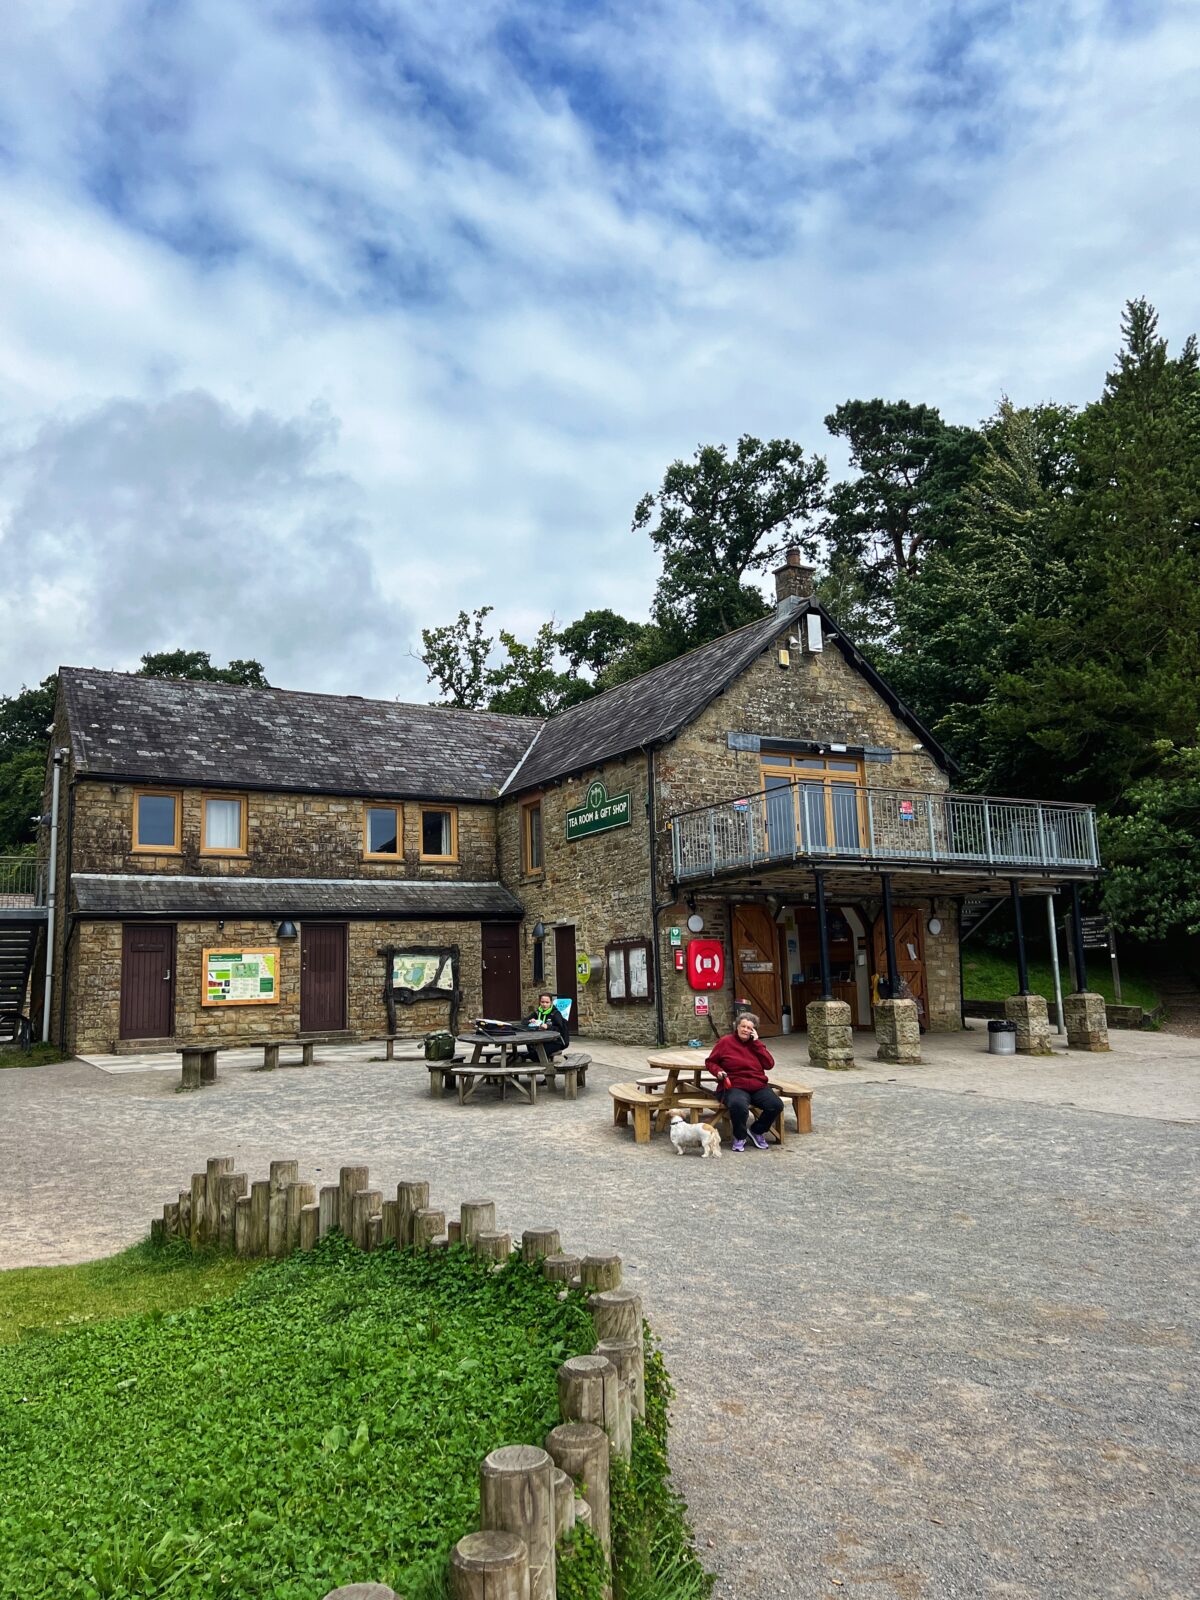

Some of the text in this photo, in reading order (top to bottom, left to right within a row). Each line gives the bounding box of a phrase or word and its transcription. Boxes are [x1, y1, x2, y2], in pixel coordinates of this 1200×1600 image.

[569, 802, 627, 828] TEA ROOM & GIFT SHOP
